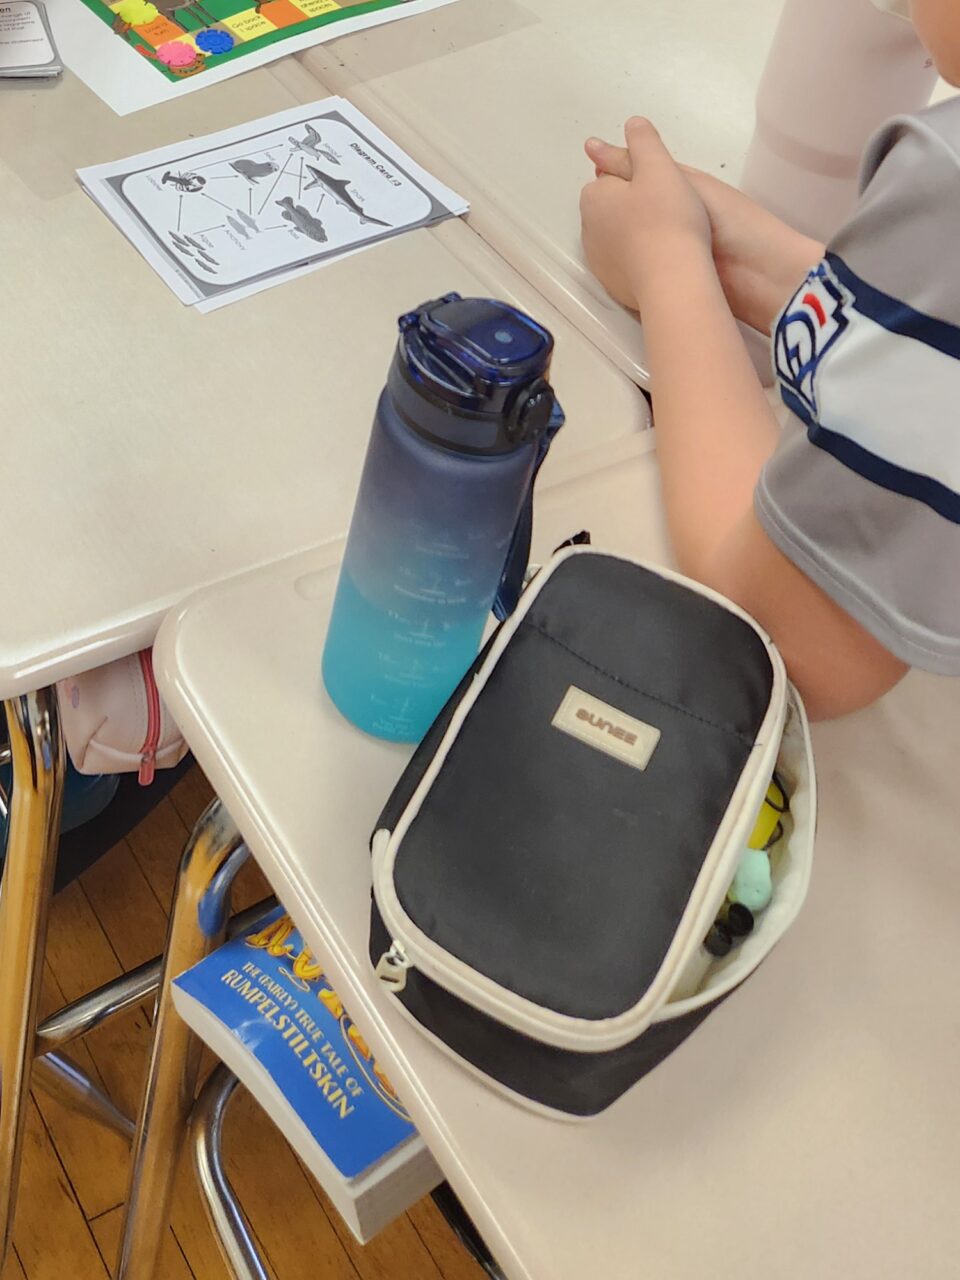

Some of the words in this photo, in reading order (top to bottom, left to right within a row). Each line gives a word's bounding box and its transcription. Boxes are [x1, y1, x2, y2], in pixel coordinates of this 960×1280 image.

[243, 15, 261, 25] back
[349, 143, 377, 165] Diagram
[375, 164, 393, 180] Card
[221, 969, 356, 1119] RUMPELSTILTSKIN
[242, 962, 258, 978] THE
[259, 974, 298, 1011] (FAIRLY)
[295, 1008, 325, 1043] TRUE
[321, 1042, 348, 1078] TALE
[345, 1077, 365, 1097] OF
